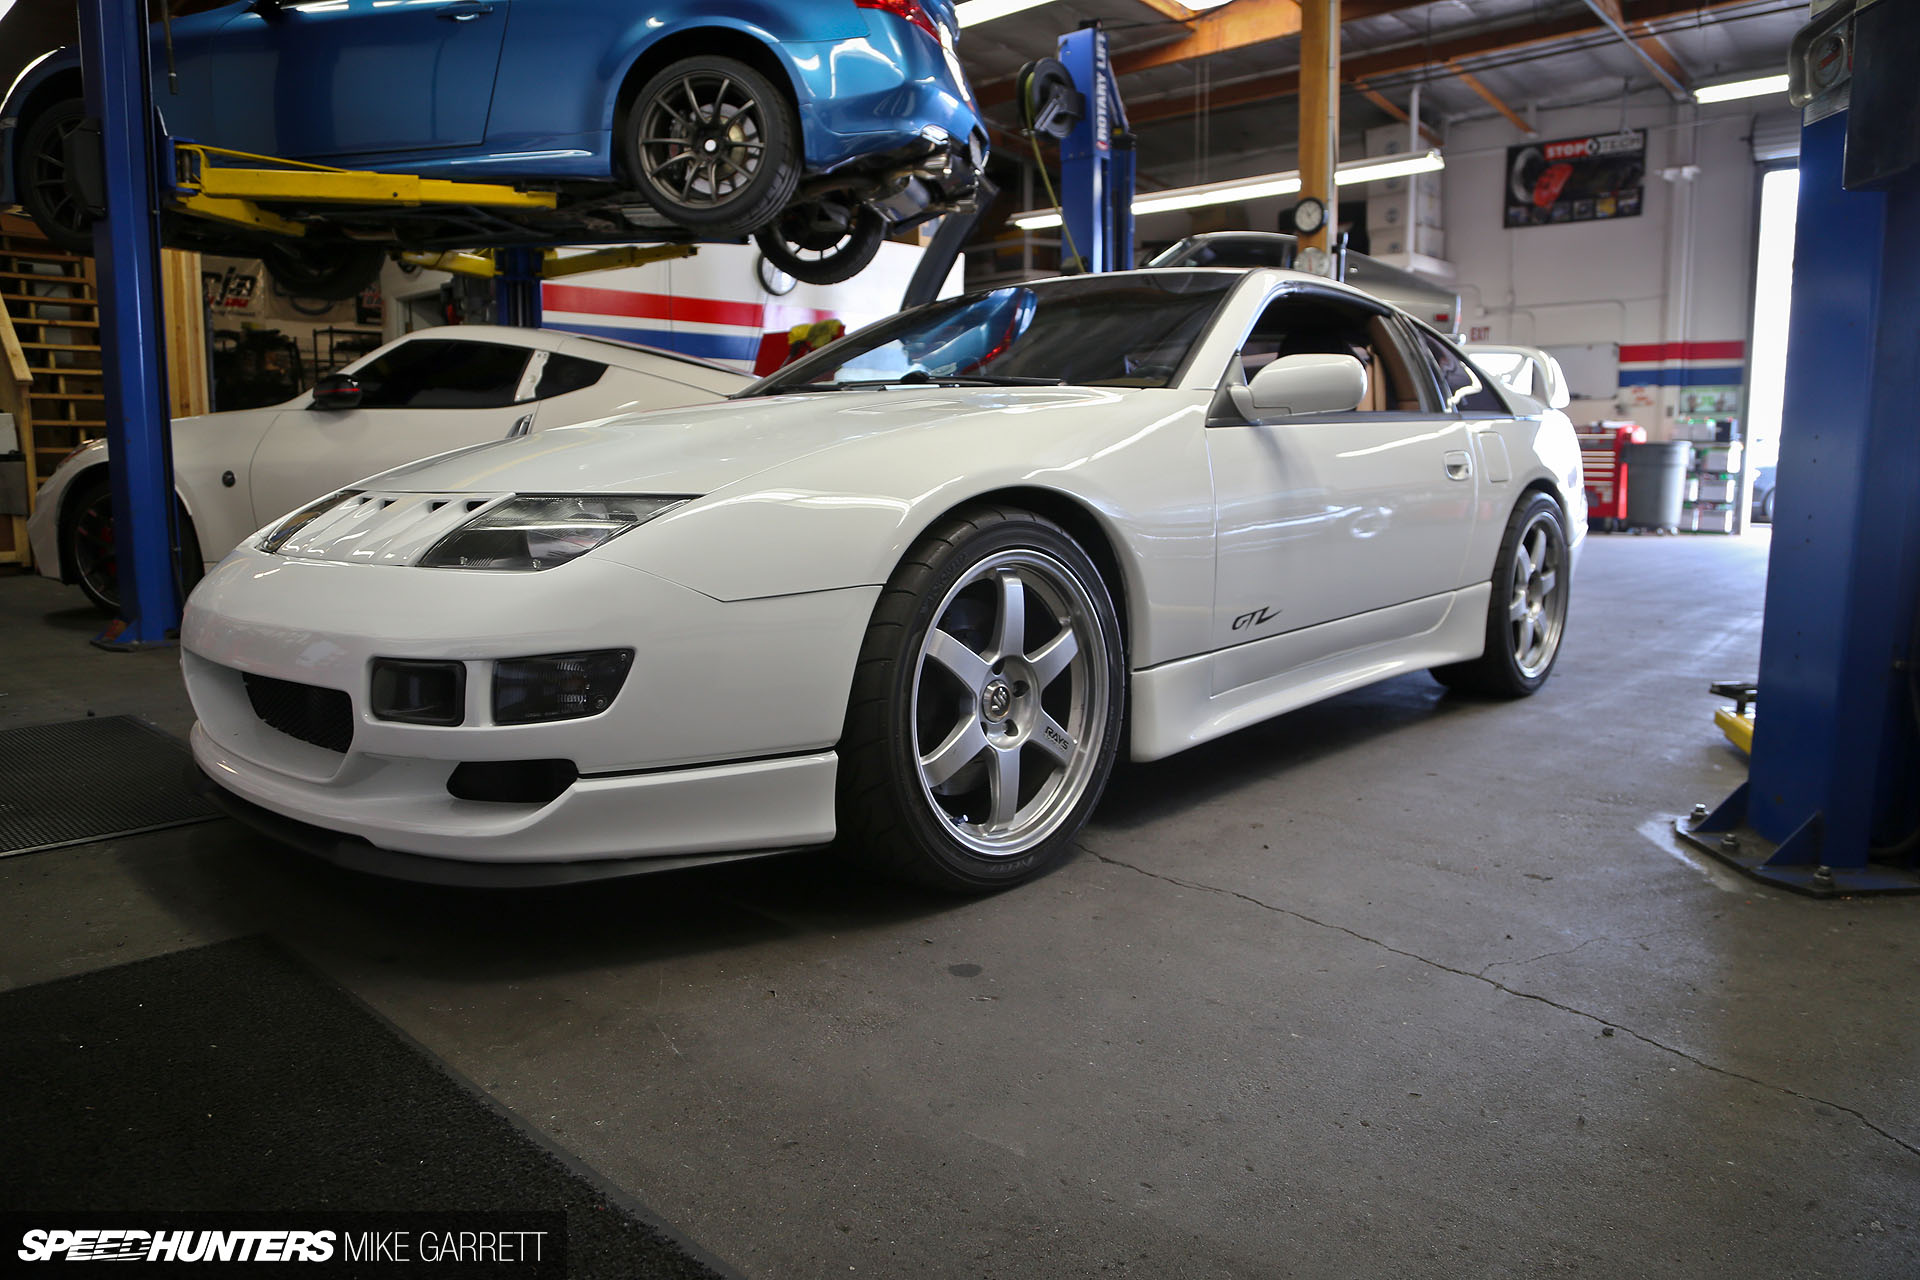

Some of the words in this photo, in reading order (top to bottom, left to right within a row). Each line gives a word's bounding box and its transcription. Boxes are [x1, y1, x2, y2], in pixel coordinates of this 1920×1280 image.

[1095, 31, 1107, 70] LIFT
[1095, 70, 1108, 141] ROTARY
[1470, 326, 1490, 342] EXIT
[1044, 725, 1070, 751] RAYS
